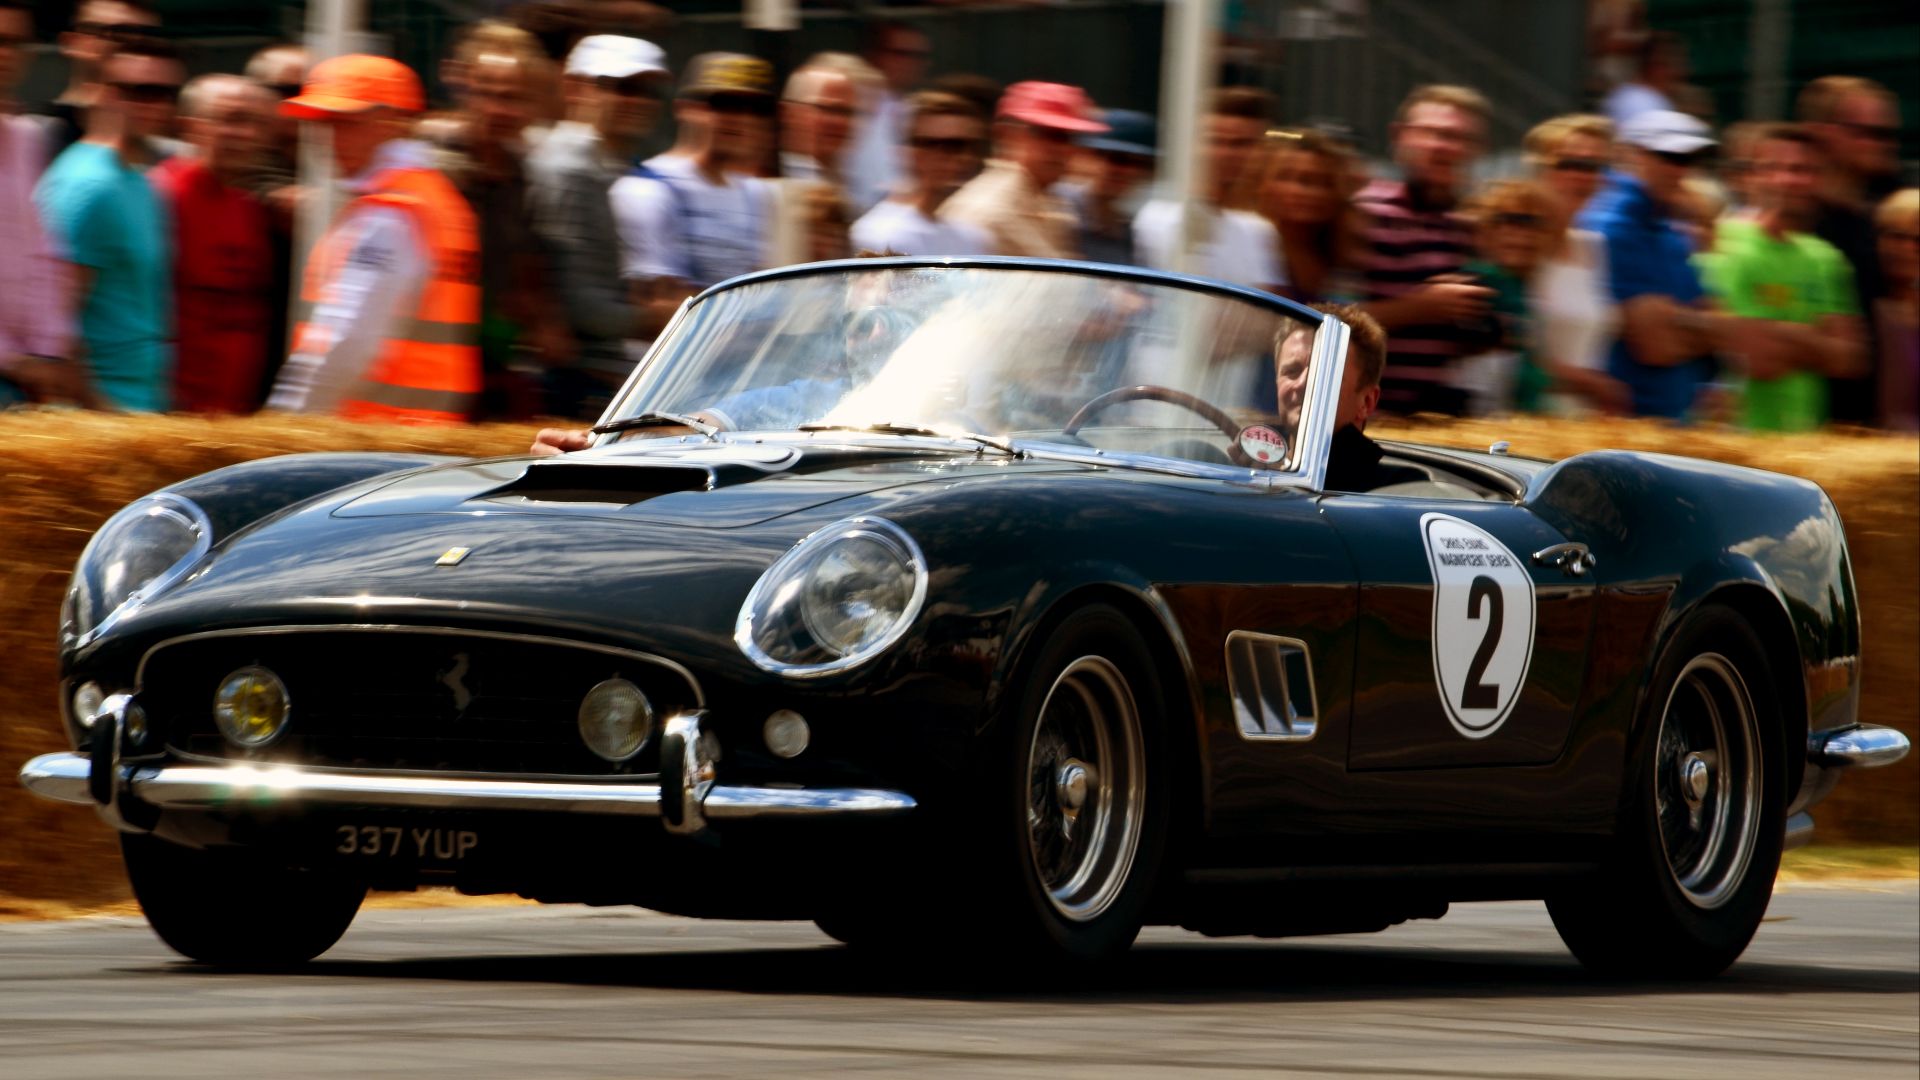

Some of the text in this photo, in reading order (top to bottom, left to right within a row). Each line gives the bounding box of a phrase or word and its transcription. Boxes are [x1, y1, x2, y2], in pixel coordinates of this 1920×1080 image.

[1461, 574, 1504, 709] 2
[336, 825, 478, 860] 337 YUP
